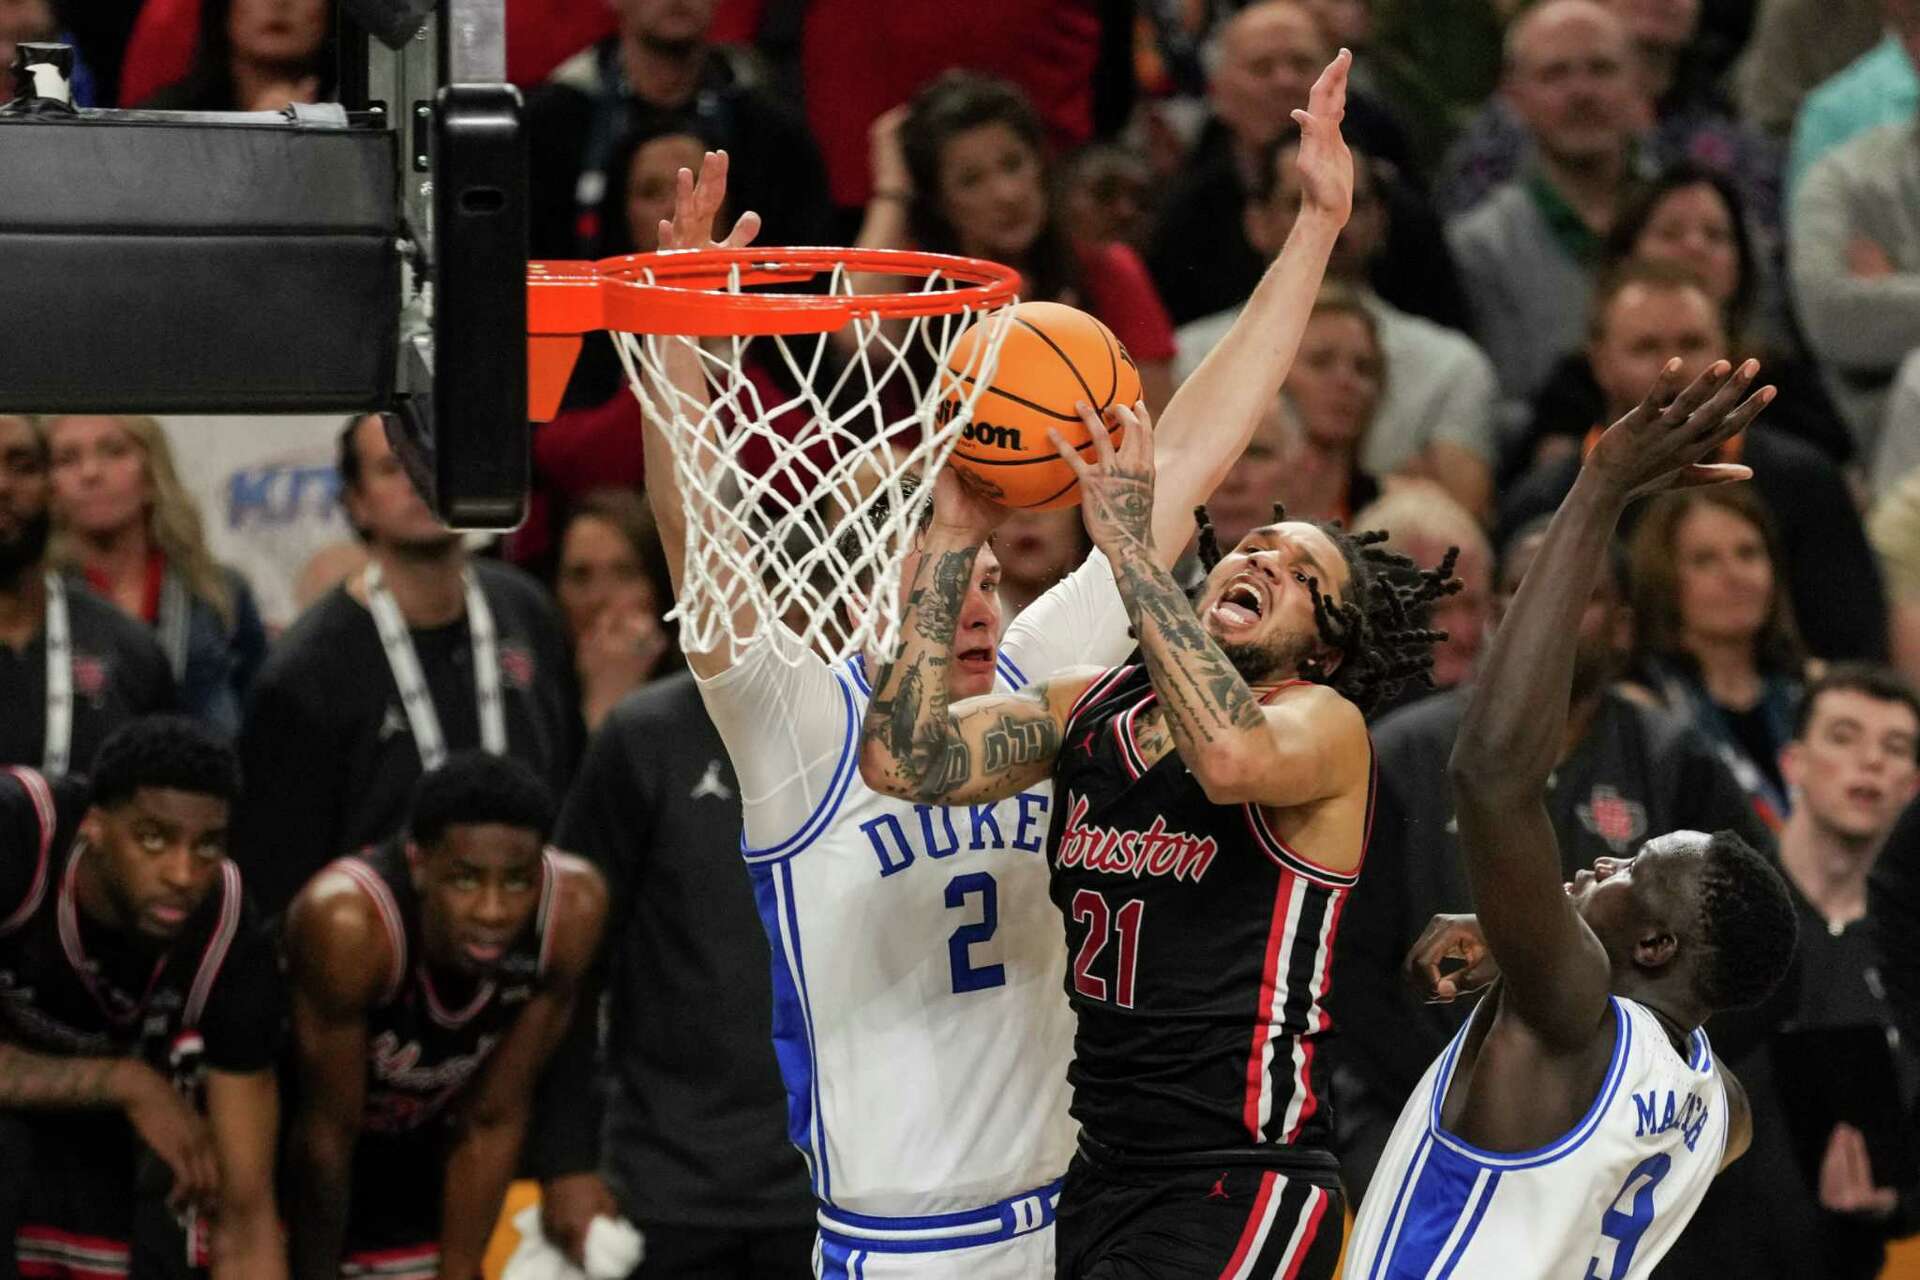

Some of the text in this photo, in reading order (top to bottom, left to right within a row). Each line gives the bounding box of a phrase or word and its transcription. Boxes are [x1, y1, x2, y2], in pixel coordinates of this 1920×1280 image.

[859, 793, 1049, 878] DUKE
[1055, 788, 1218, 883] Houston
[944, 871, 1006, 994] 2
[1072, 888, 1145, 1010] 21
[1584, 1152, 1671, 1280] 9
